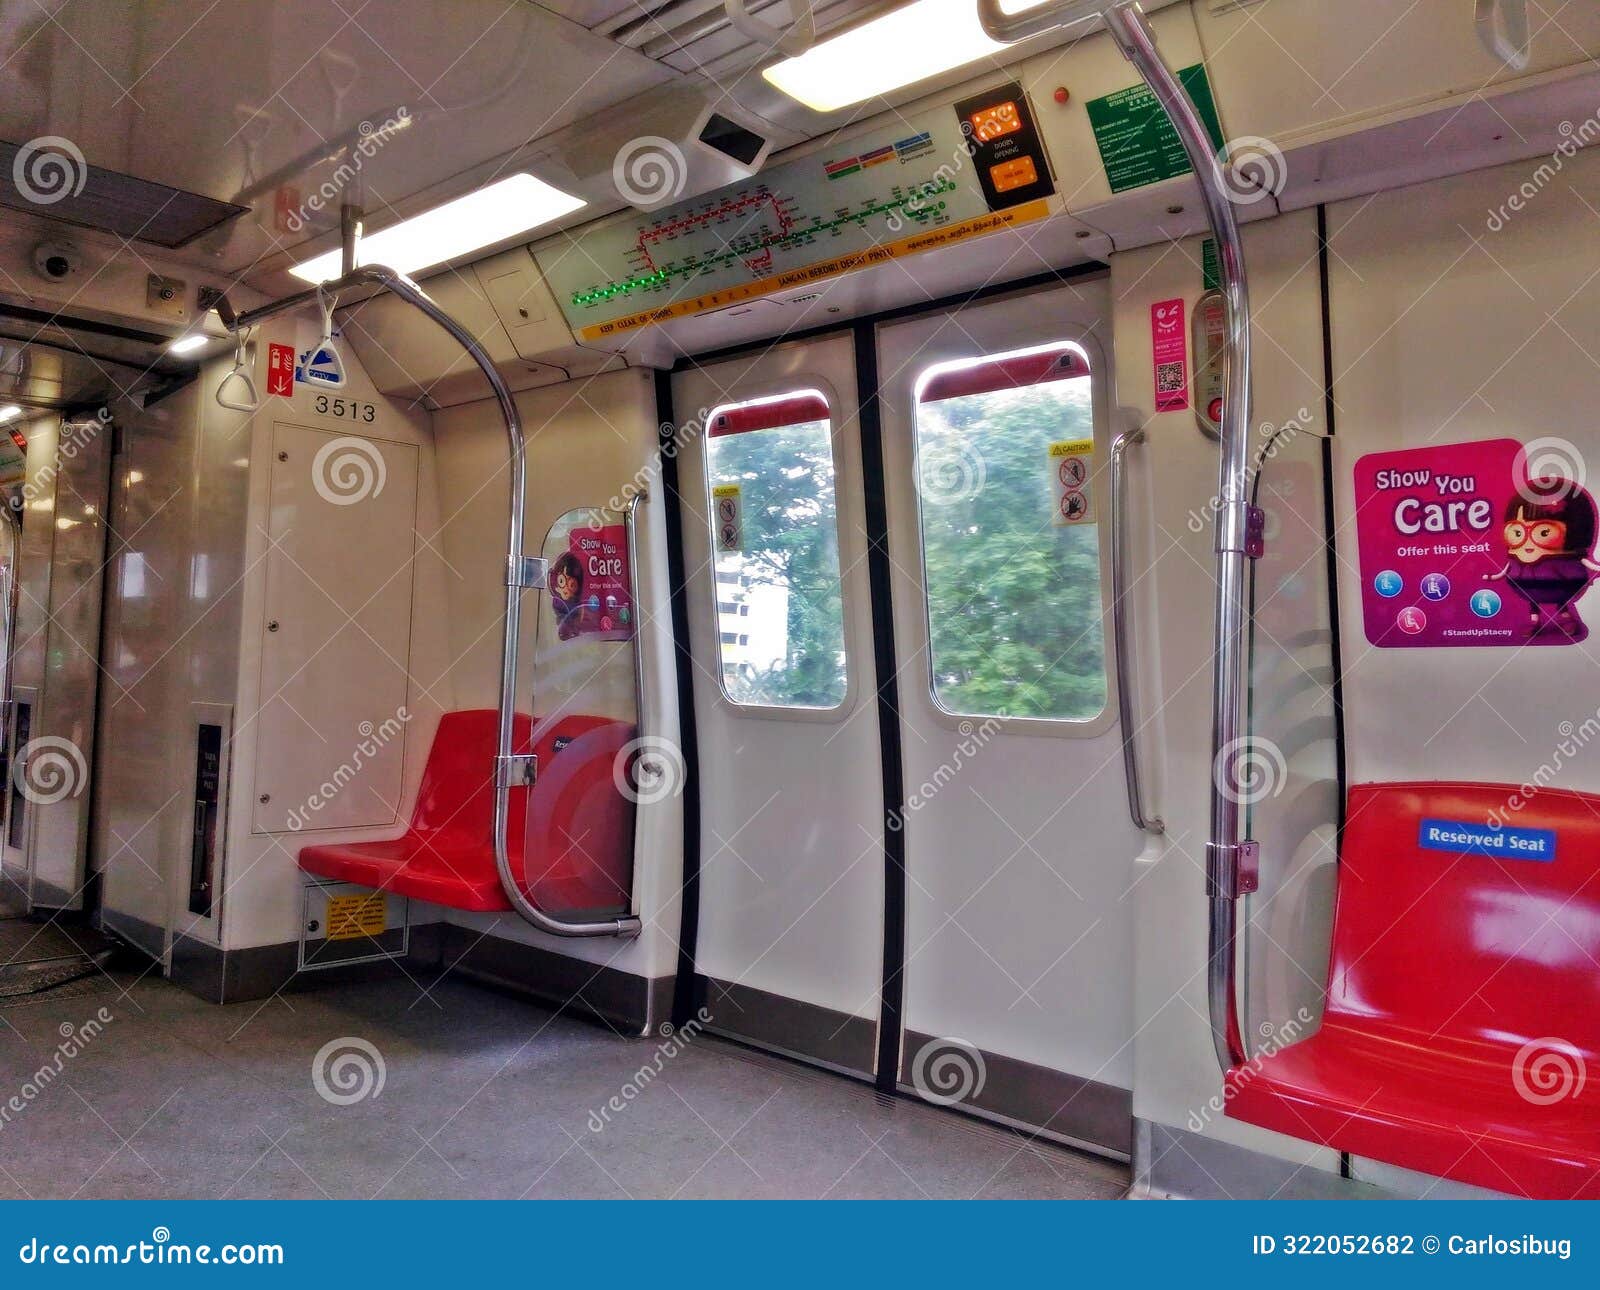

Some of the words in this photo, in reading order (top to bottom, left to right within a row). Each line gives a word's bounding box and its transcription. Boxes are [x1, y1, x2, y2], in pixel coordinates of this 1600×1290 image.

[778, 270, 807, 287] JANGAN
[809, 263, 839, 280] BERDIRI
[841, 256, 866, 270] DEKAT
[868, 247, 895, 263] PINTU
[618, 318, 637, 329] CLEAR
[315, 395, 376, 423] 3513
[1063, 443, 1090, 453] CAUTION
[1376, 468, 1430, 490] Show
[1435, 475, 1475, 494] You
[1394, 498, 1491, 534] Care
[581, 538, 600, 550] Show
[602, 544, 616, 554] You
[1397, 546, 1430, 557] Offer
[1433, 544, 1458, 555] this
[1461, 542, 1491, 553] seat
[588, 556, 622, 576] Care
[1443, 627, 1513, 638] #StandUpStacey
[1429, 827, 1504, 847] Reserved
[1509, 836, 1545, 852] Seat
